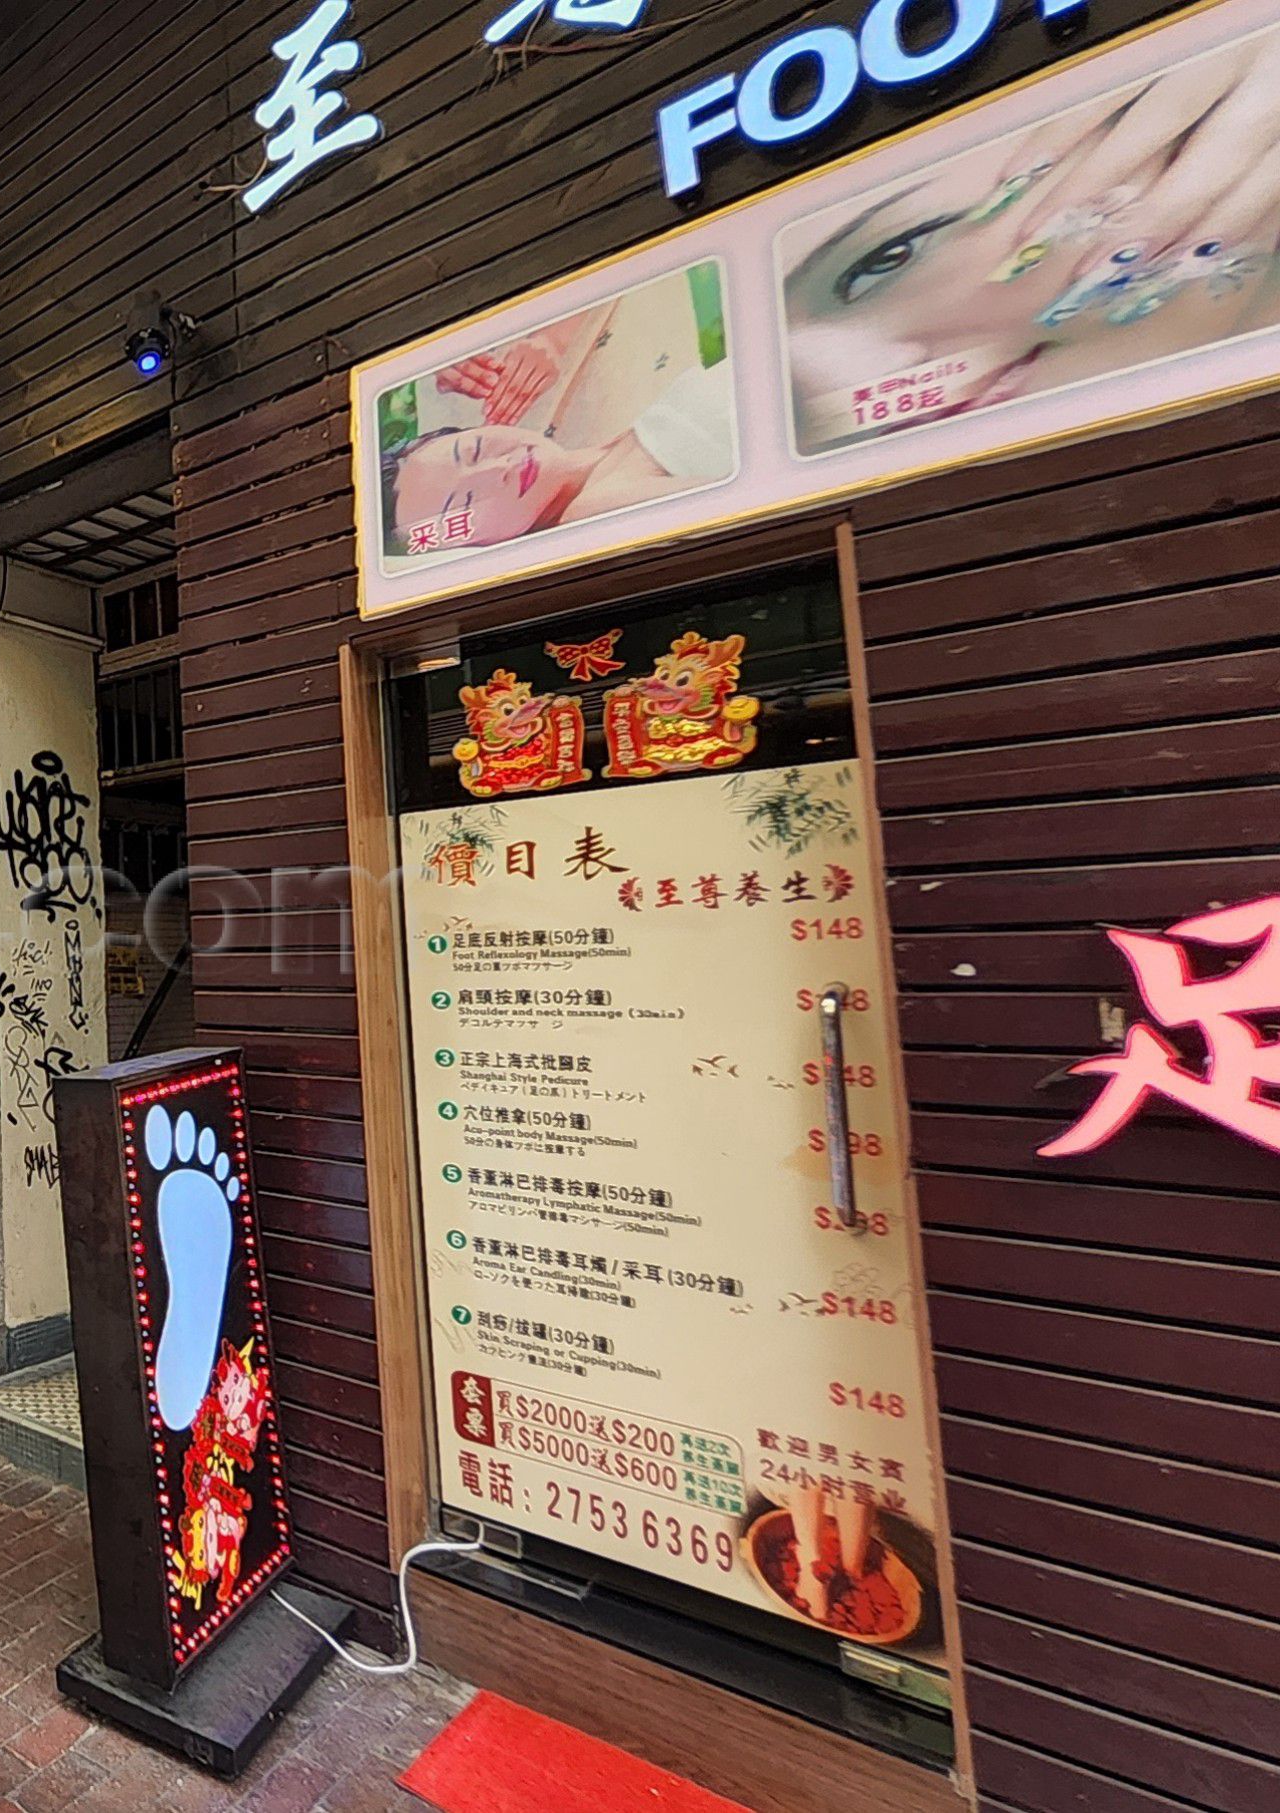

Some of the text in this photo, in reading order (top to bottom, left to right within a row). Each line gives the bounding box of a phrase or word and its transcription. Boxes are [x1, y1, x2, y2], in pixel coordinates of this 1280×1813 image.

[407, 512, 475, 553] 采耳
[428, 826, 631, 887] 價目表
[654, 870, 818, 911] 至尊養生
[790, 917, 864, 941] $148
[452, 950, 475, 961] Foot
[477, 949, 538, 961] Reflexology
[457, 1007, 509, 1017] Shoulder
[512, 1007, 534, 1017] and
[536, 1008, 563, 1018] neck
[567, 1009, 623, 1019] massage
[460, 1070, 589, 1087] Shanghai Style Pedicure
[802, 1062, 876, 1088] $48
[517, 1128, 543, 1142] body
[808, 1128, 883, 1157] $98
[468, 1186, 541, 1207] Aromatherapy
[543, 1196, 601, 1214] Lymphatic
[473, 1256, 506, 1271] Aroma
[509, 1261, 526, 1274] Ear
[821, 1292, 898, 1325] $148
[477, 1330, 500, 1344] Skin
[503, 1333, 550, 1356] Scraping
[554, 1348, 565, 1358] or
[829, 1382, 906, 1419] $148
[546, 1481, 628, 1539] 2753
[642, 1509, 734, 1573] 6369
